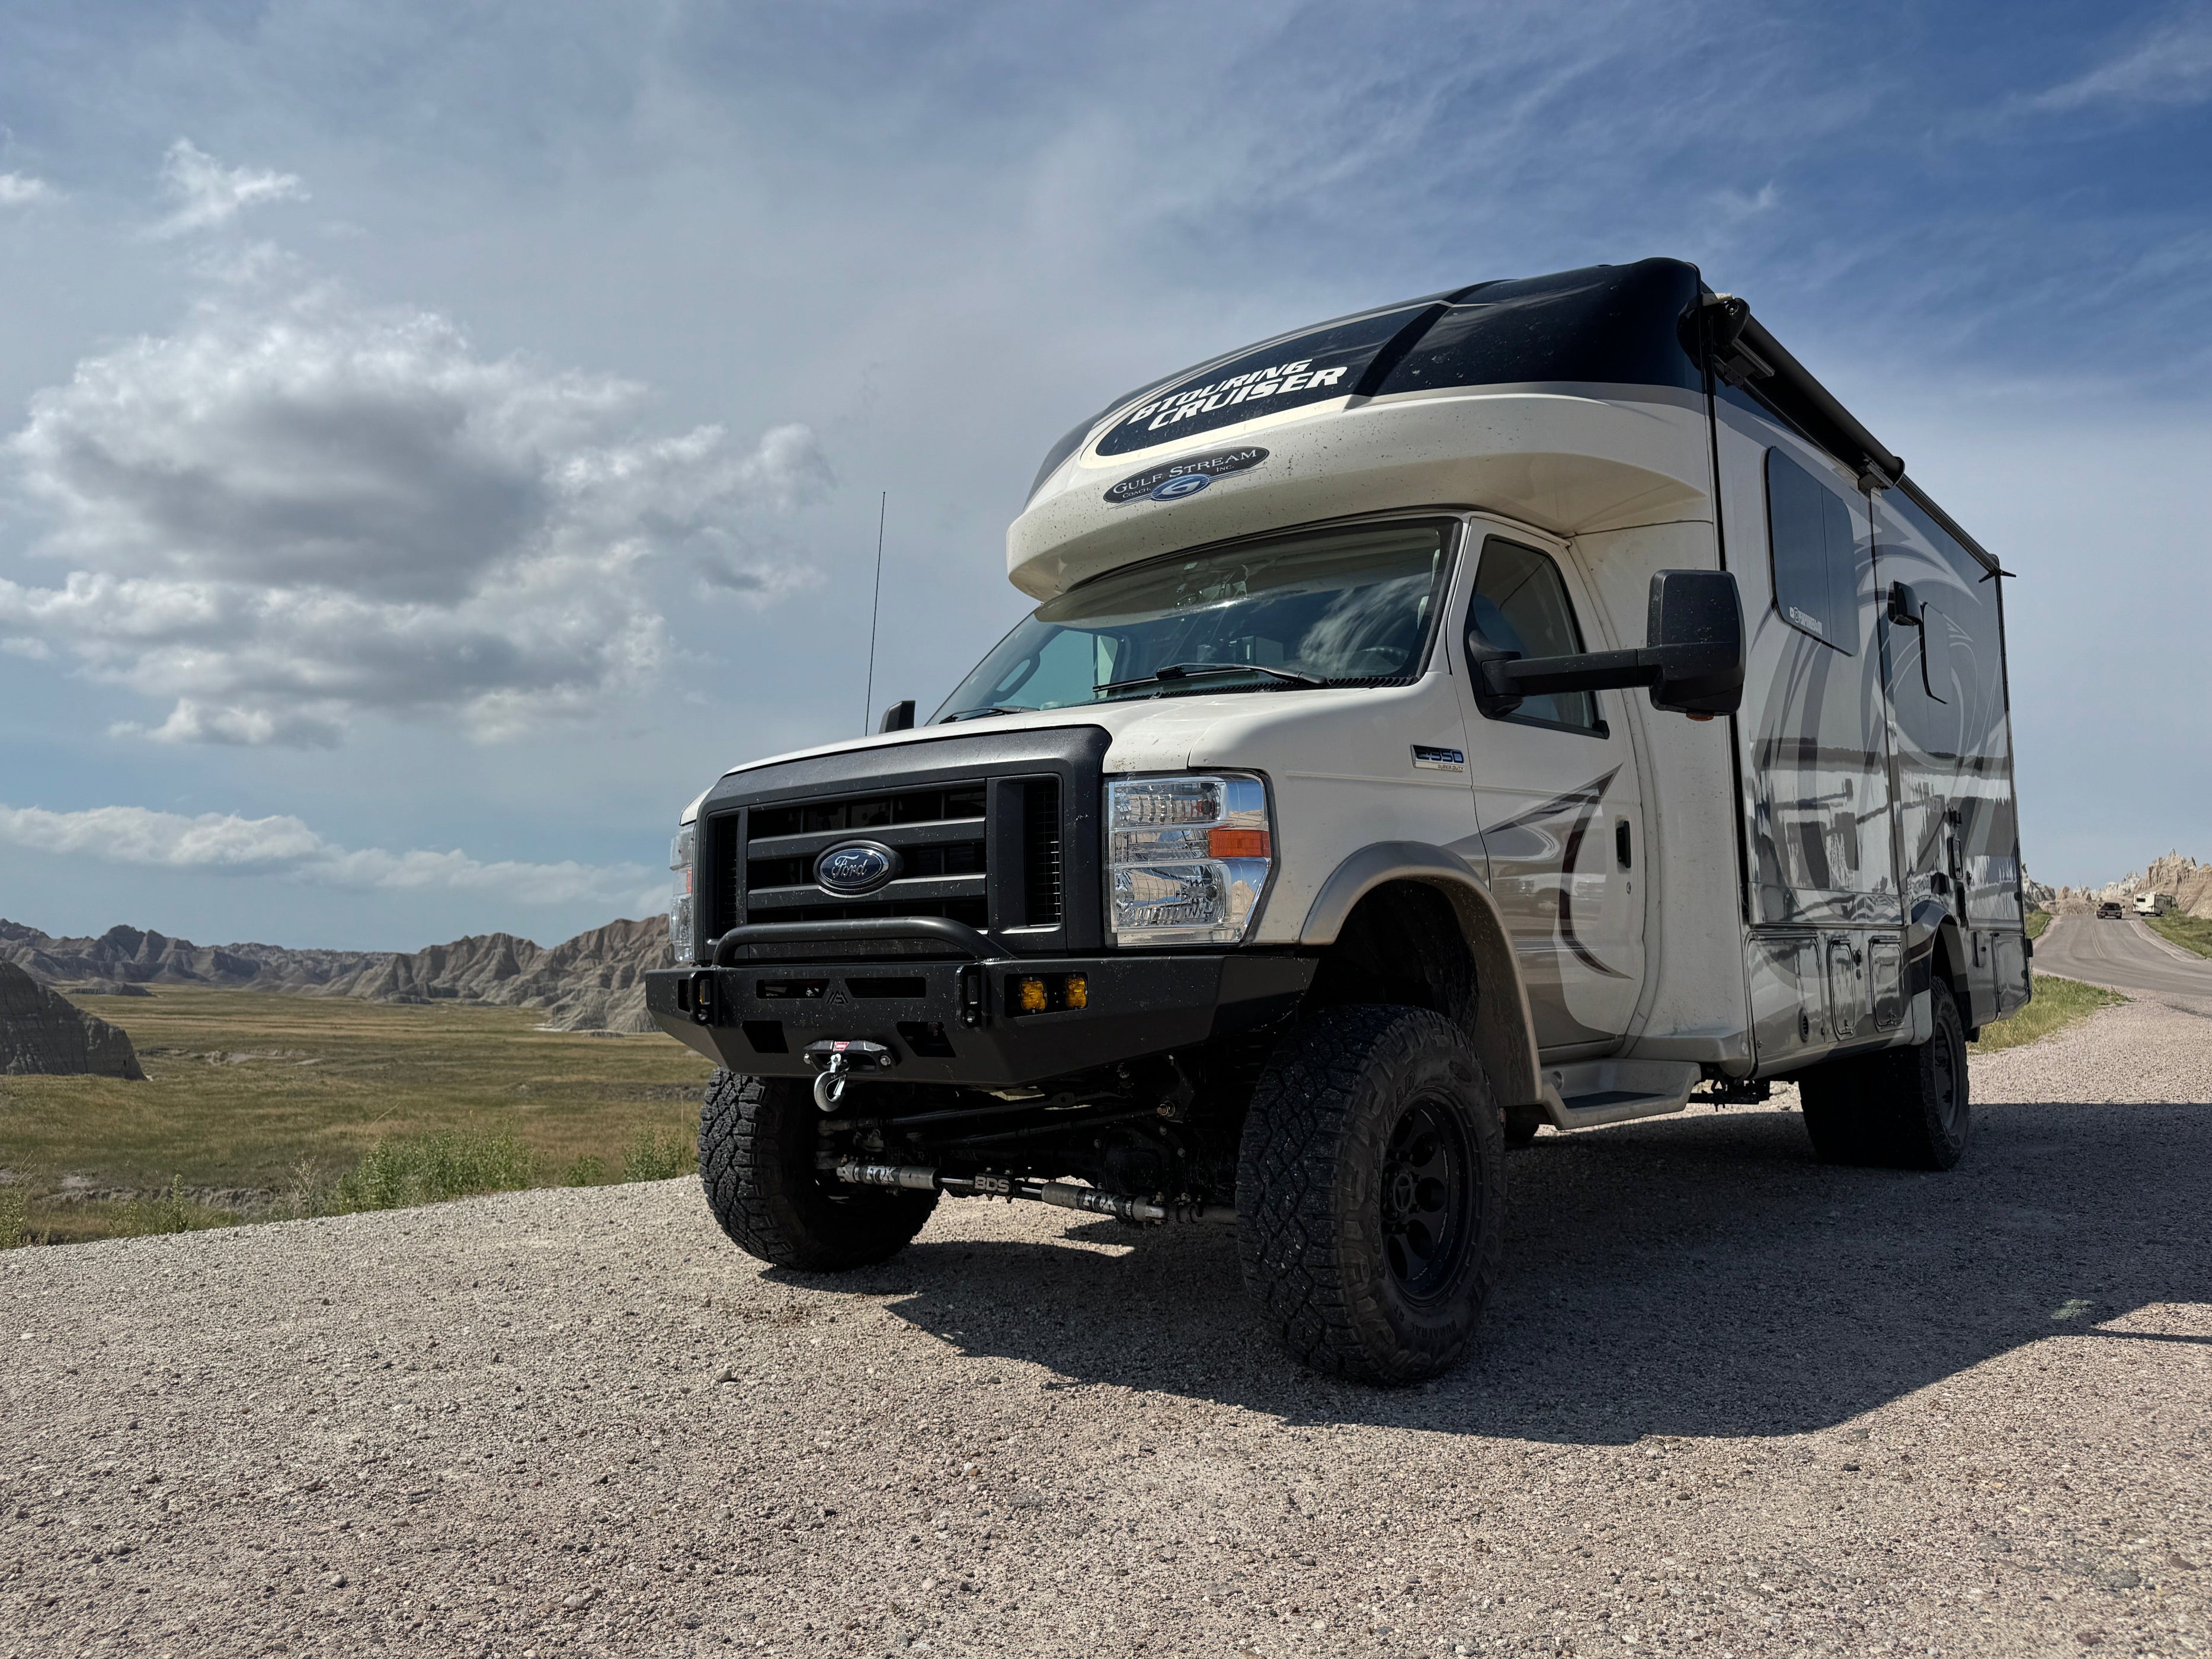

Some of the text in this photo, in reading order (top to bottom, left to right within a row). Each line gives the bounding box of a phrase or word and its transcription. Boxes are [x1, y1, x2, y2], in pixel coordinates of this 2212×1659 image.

[1127, 358, 1313, 425] BTOURING
[1148, 367, 1347, 431] CRUISER
[1113, 449, 1257, 494] GULF STREAM
[831, 854, 867, 879] Ford
[866, 1164, 898, 1184] FOX
[974, 1175, 1010, 1193] BDS
[1083, 1189, 1120, 1214] FOX
